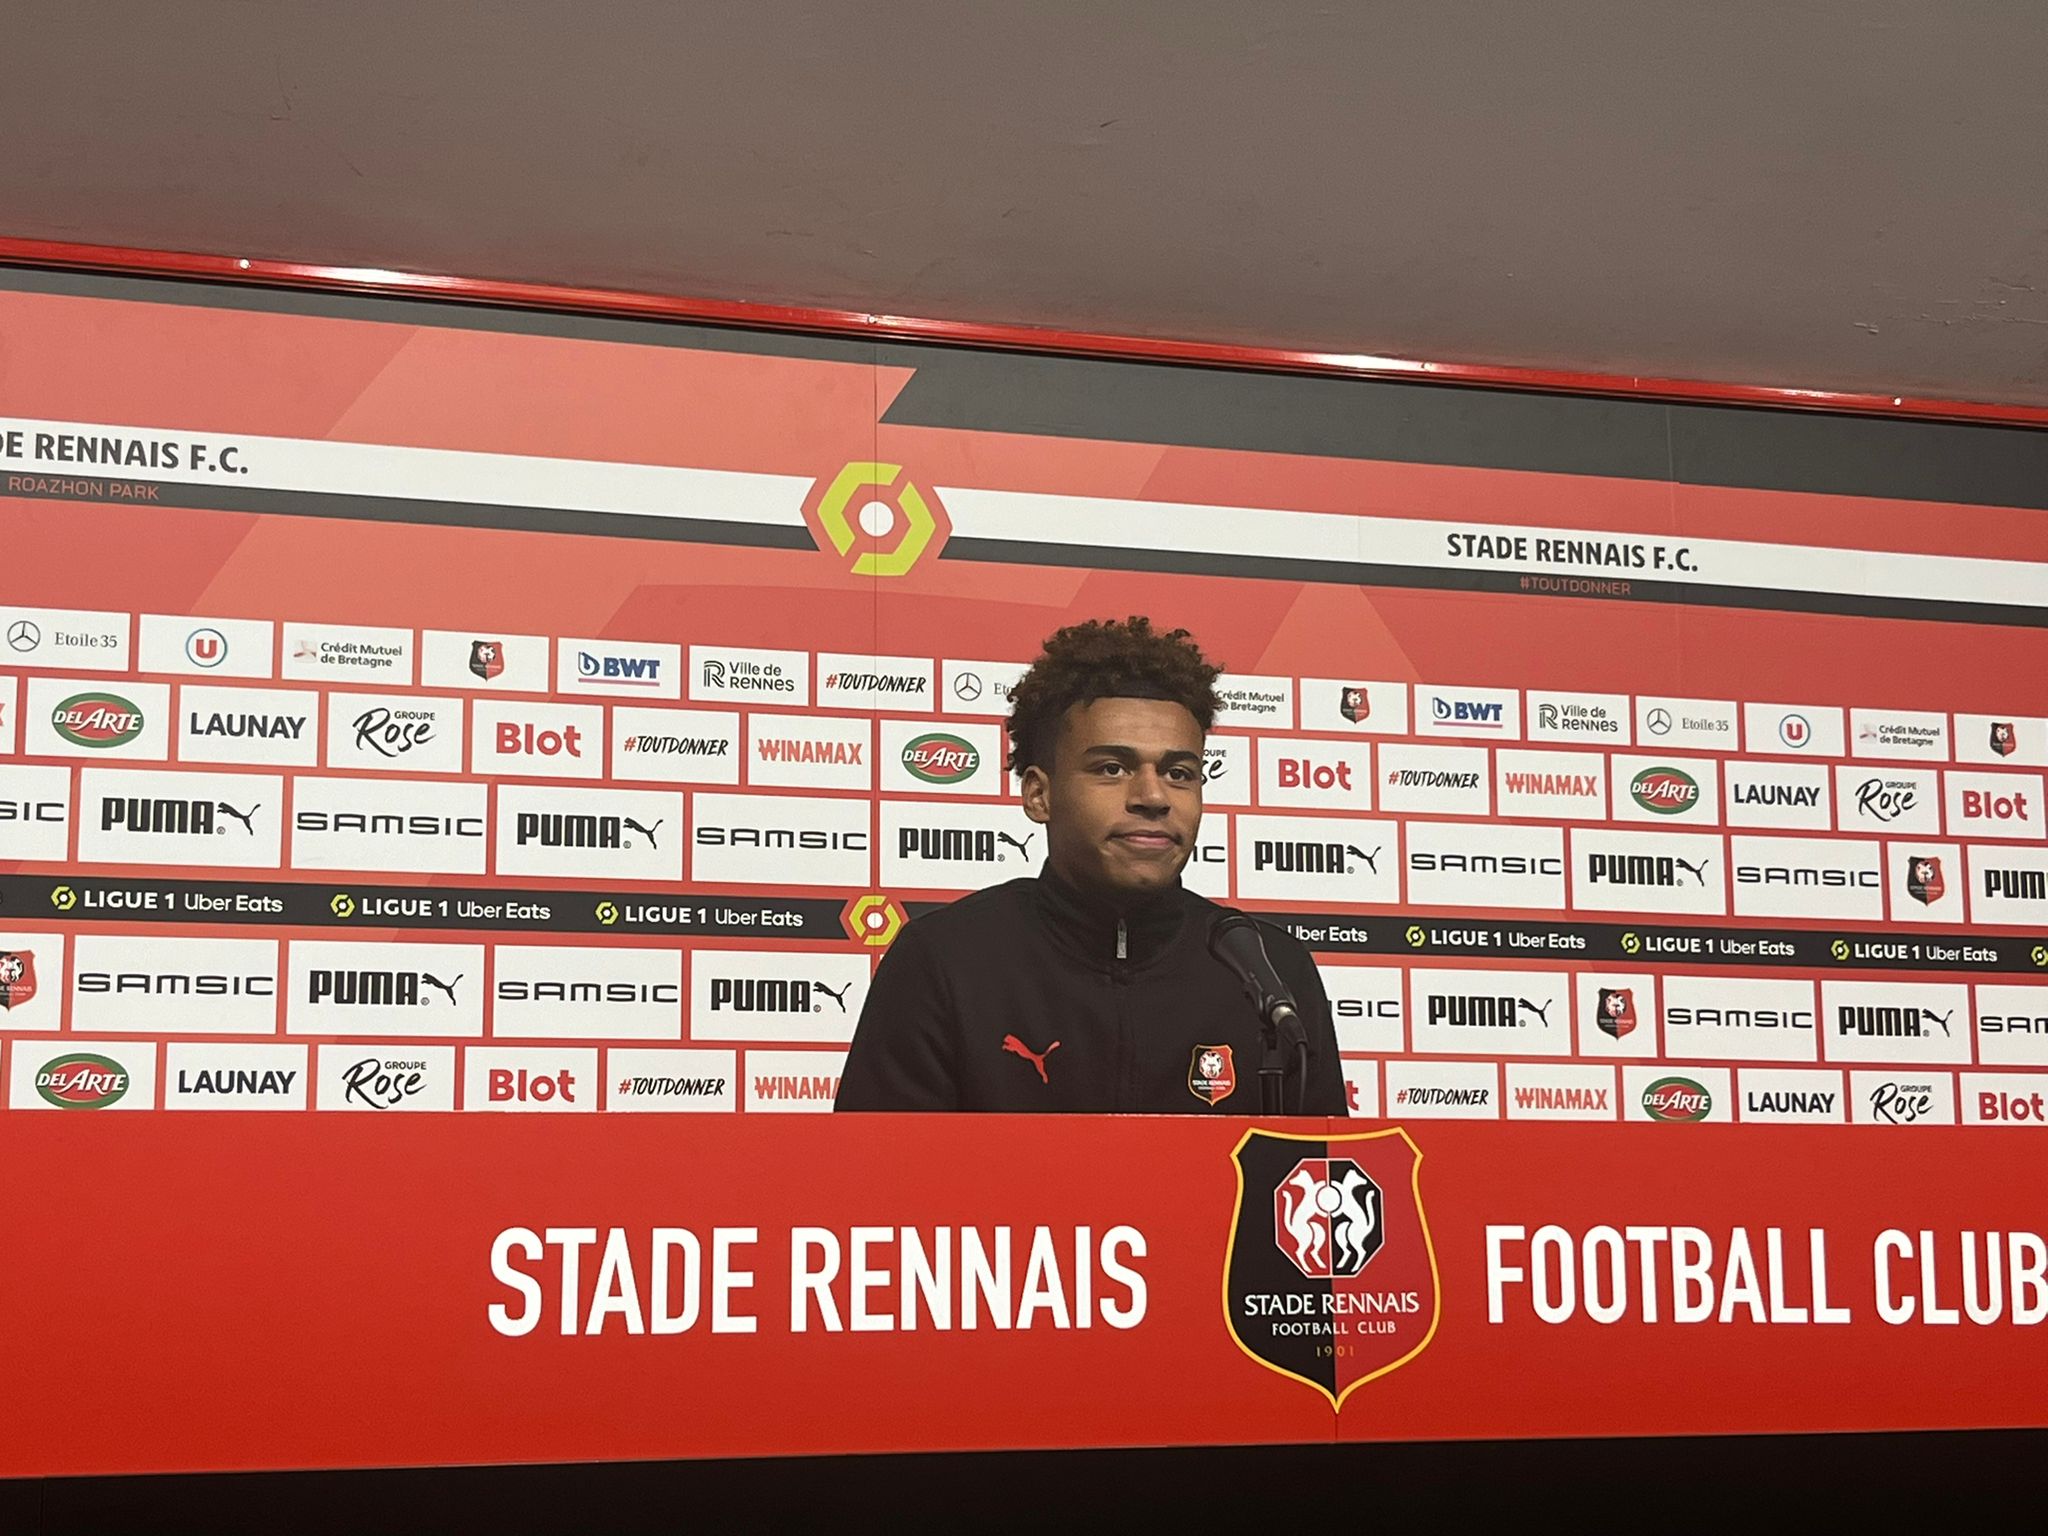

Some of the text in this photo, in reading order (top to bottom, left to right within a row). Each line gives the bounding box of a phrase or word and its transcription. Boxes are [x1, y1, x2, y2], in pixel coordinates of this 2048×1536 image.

[35, 433, 178, 469] RENNAIS
[191, 445, 248, 474] F.C.
[9, 476, 159, 500] ROAZHON PARK
[1447, 533, 1697, 571] STADE RENNAIS F.C.
[1520, 577, 1630, 595] #TOUTDONNER
[55, 632, 117, 648] Etoile 35
[196, 639, 217, 659] U
[321, 643, 402, 656] Crédit Mutuel
[321, 654, 392, 668] de Bretagne
[604, 657, 660, 679] BWT
[729, 662, 781, 676] Ville de
[826, 673, 926, 693] #TOUTDONNER
[1249, 692, 1284, 702] Mutuel
[394, 710, 436, 721] GROUPE
[1231, 702, 1276, 714] Bretagne
[1455, 702, 1502, 721] BWT
[1561, 705, 1606, 718] Ville de
[191, 712, 306, 739] LAUNAY
[352, 708, 435, 757] Rose
[1682, 718, 1729, 731] Etoile 35
[1787, 724, 1802, 740] U
[1879, 725, 1940, 736] Crédit Mutuel
[496, 722, 581, 758] Blot
[625, 736, 728, 756] #TOUTDONNER
[1880, 735, 1933, 747] de Bretagne
[758, 739, 862, 765] WINAMAX
[1203, 749, 1227, 757] OUPE
[1279, 759, 1351, 791] Blot
[1389, 770, 1479, 788] #TOUTDONNER
[1506, 773, 1597, 796] WINAMAX
[1885, 781, 1917, 790] GROUPE
[1734, 784, 1820, 806] LAUNAY
[1855, 779, 1917, 822] Rose
[102, 797, 214, 834] PUMA
[1962, 791, 2027, 821] Blot
[297, 813, 482, 836] SAMSIC
[517, 813, 620, 848] PUMA
[697, 827, 867, 850] SAMSIC
[899, 828, 994, 861] PUMA
[1255, 841, 1344, 873] PUMA
[1411, 854, 1561, 875] SAMSIC
[1589, 854, 1674, 886] PUMA
[1737, 867, 1879, 887] SAMSIC
[1984, 870, 2048, 899] PUM
[85, 891, 282, 912] LIGUE 1 Uber Eats
[363, 899, 550, 919] LIGUE 1 Uber Eats
[626, 906, 803, 926] LIGUE 1 Uber Eats
[1329, 927, 1367, 942] Eats
[1432, 930, 1585, 948] LIGUE 1 Uber Eats
[1646, 937, 1795, 955] LIGUE 1 Uber Eats
[1855, 944, 1997, 961] LIGUE 1 Uber Eats
[78, 973, 273, 995] SAMSIC
[309, 970, 418, 1005] PUMA
[499, 982, 677, 1003] SAMSIC
[711, 979, 810, 1012] PUMA
[1329, 1000, 1399, 1017] SIC
[1428, 995, 1516, 1027] PUMA
[1668, 1008, 1812, 1028] SAMSIC
[1838, 1006, 1920, 1037] PUMA
[385, 1061, 427, 1070] GROUPE
[179, 1070, 296, 1094] LAUNAY
[342, 1058, 427, 1109] Rose
[489, 1069, 575, 1103] Blot
[619, 1078, 725, 1096] #TOUTDONNER
[755, 1076, 841, 1099] WINAM
[1900, 1085, 1932, 1093] GROUPE
[1397, 1088, 1489, 1105] #TOUTDONNER
[1515, 1088, 1608, 1110] WINAMAX
[1748, 1092, 1835, 1113] LAUNAY
[1870, 1082, 1933, 1124] Rose
[1979, 1092, 2044, 1121] Blot
[489, 1226, 1147, 1336] STADE RENNAIS
[1486, 1225, 2048, 1325] FOOTBALL CLUB
[1244, 1291, 1420, 1316] STADE RENNAIS
[1272, 1321, 1396, 1336] FOOTBALL CLUB
[1316, 1345, 1354, 1357] 1901
